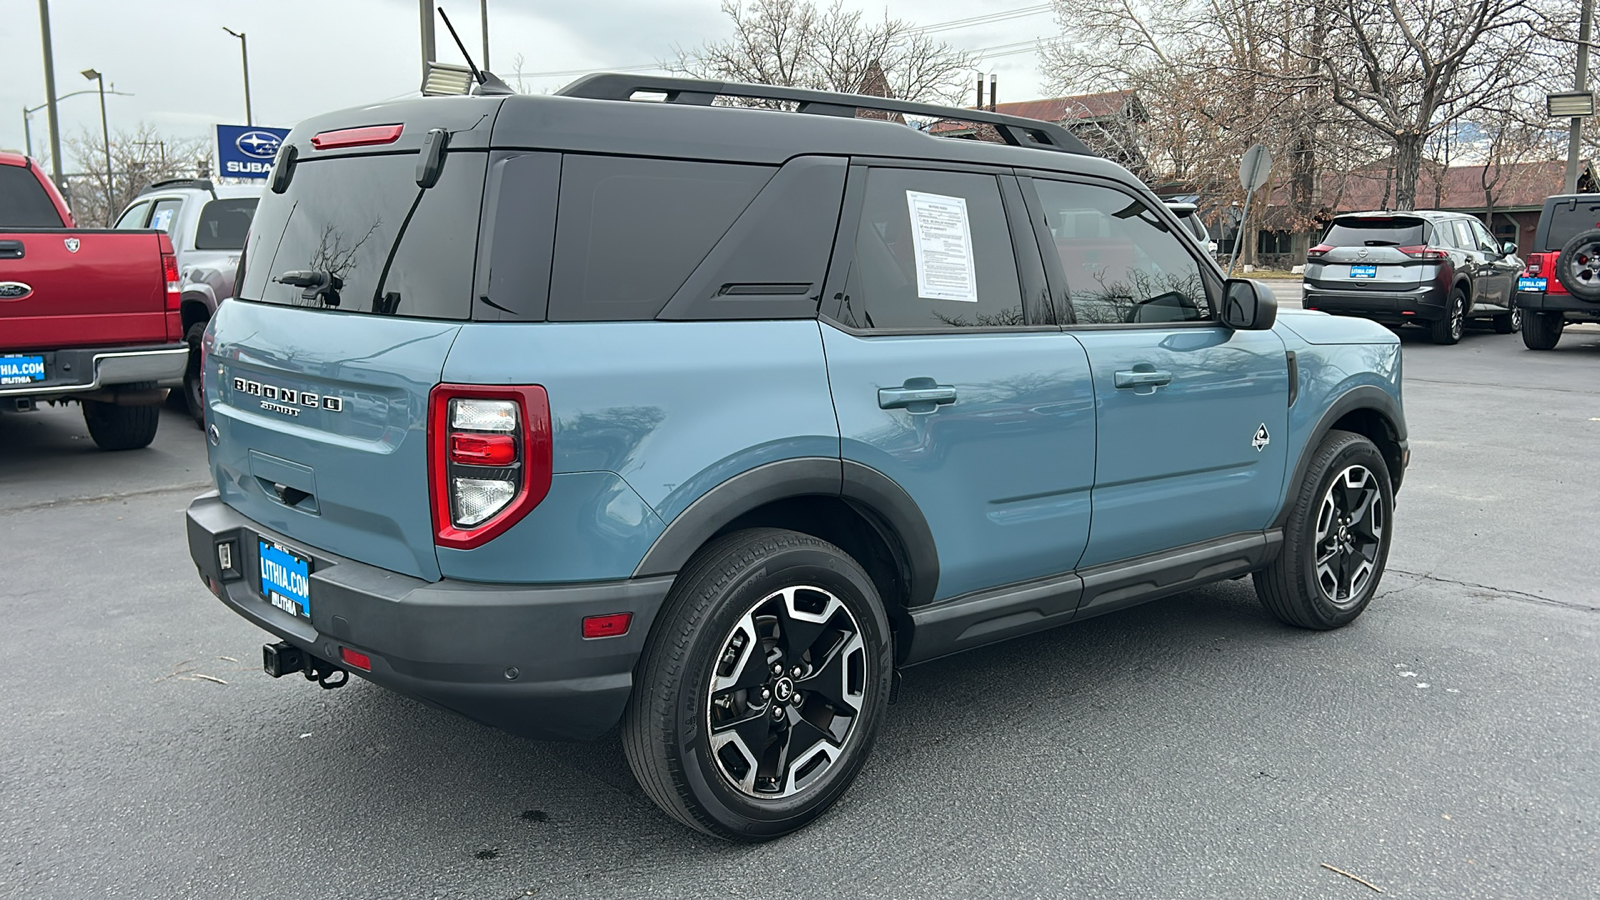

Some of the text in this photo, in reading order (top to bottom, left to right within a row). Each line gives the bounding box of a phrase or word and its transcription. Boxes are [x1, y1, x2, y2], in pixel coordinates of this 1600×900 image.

[233, 377, 343, 412] BRONCO
[260, 400, 301, 417] SPORT
[261, 556, 309, 599] LITHIA.COM
[277, 594, 297, 617] LITHIA
